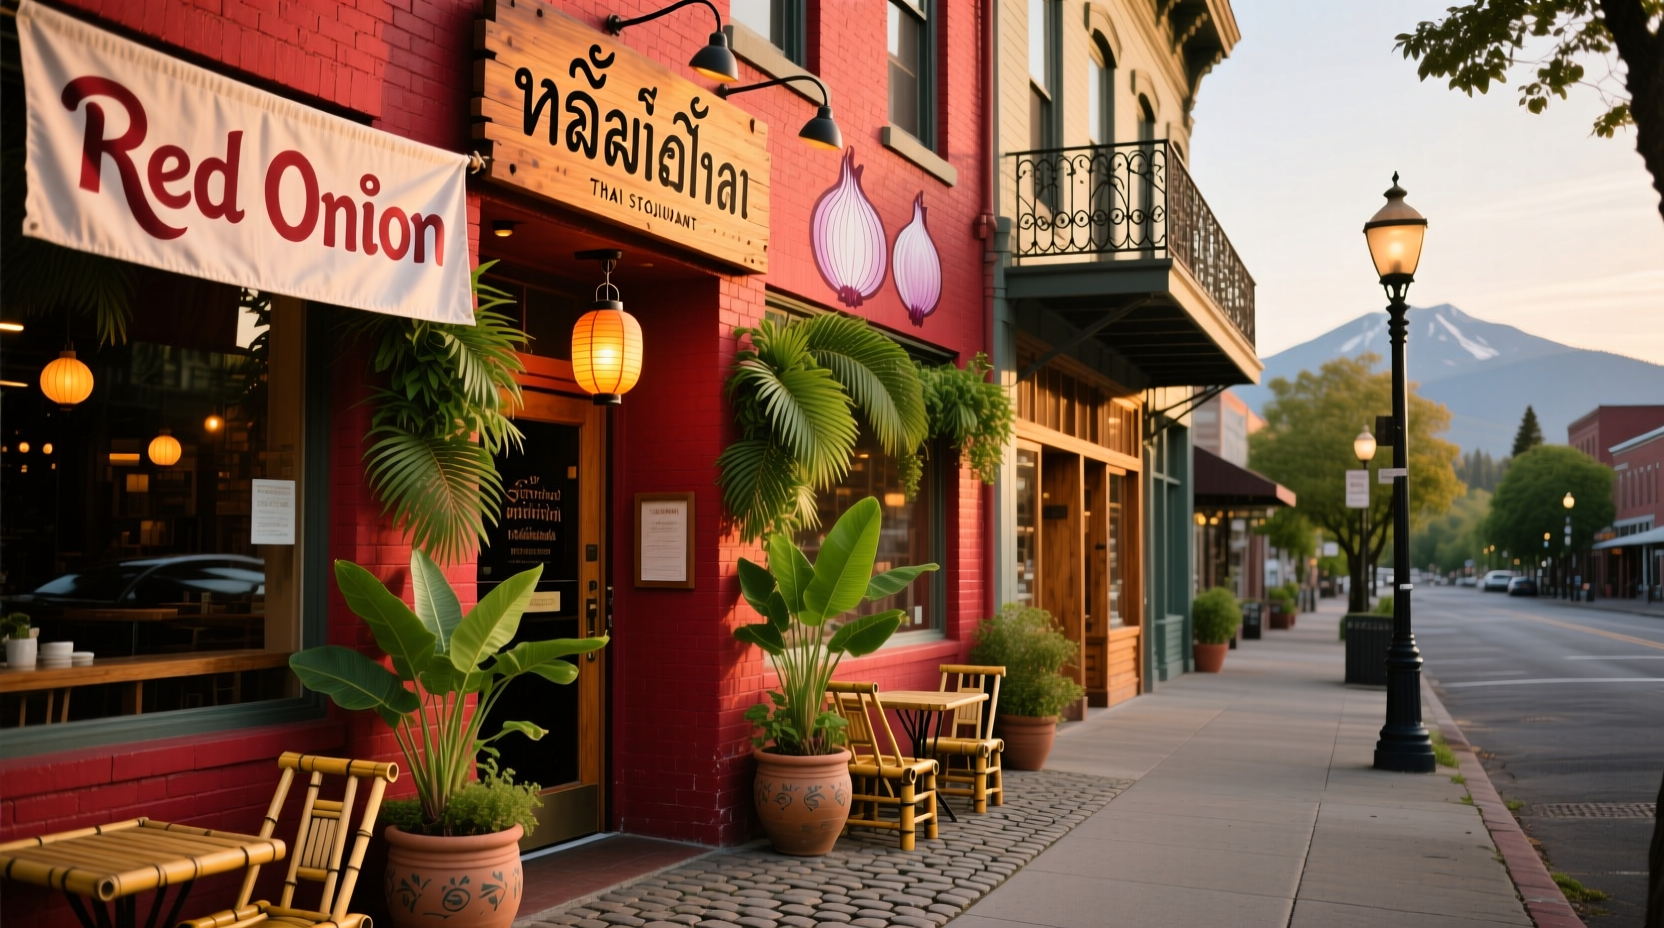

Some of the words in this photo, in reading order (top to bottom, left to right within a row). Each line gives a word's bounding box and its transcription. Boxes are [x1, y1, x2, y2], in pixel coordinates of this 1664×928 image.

[61, 75, 246, 240] Red
[264, 149, 446, 267] Onion
[590, 177, 623, 206] THAI
